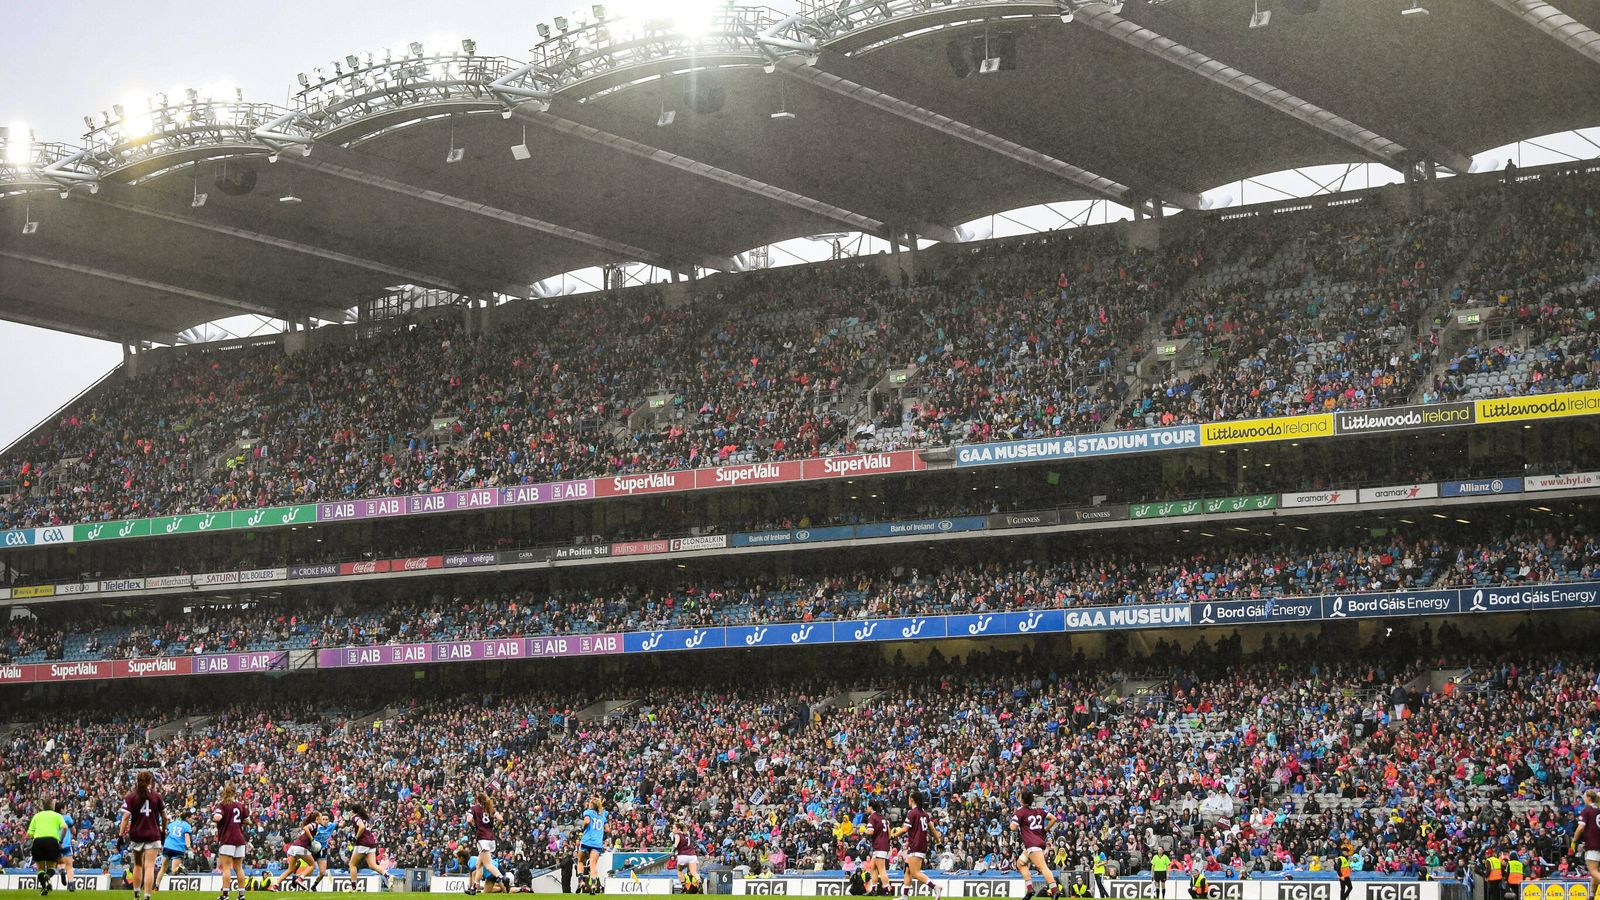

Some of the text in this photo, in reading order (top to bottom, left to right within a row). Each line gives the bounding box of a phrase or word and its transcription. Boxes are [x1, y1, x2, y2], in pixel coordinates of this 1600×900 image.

[959, 430, 1195, 462] GAA MUSEUM & STADIUM TOUR
[824, 455, 891, 475] SuperValu
[716, 465, 779, 485] SuperValu
[1540, 475, 1592, 487] www.hyl.ie
[614, 473, 675, 493] SuperValu
[1459, 483, 1490, 493] Allianz
[517, 488, 539, 502] AIB
[565, 483, 587, 498] AIB
[1375, 488, 1408, 498] aramark
[424, 496, 445, 510] AIB
[469, 492, 491, 505] AIB
[1297, 494, 1329, 503] aramark
[334, 504, 355, 518] AIB
[379, 500, 399, 514] AIB
[199, 514, 215, 530] eir
[248, 510, 265, 525] eir
[282, 507, 299, 524] eir
[1012, 516, 1040, 524] GUINNESS
[1082, 512, 1110, 520] GUINNESS
[88, 524, 103, 539] eir
[119, 521, 135, 537] eir
[166, 517, 183, 532] eir
[890, 525, 906, 533] Bank
[913, 523, 935, 531] Ireland
[6, 532, 27, 545] GAA
[43, 529, 64, 542] GAA
[682, 536, 724, 546] CLONDALKIN
[770, 533, 790, 541] Ireland
[556, 550, 567, 558] An
[594, 546, 608, 555] Stil
[240, 572, 250, 581] OIL
[251, 570, 274, 580] BOILERS
[298, 565, 336, 576] CROKE PARK
[206, 573, 237, 583] SATURN
[104, 580, 141, 591] Teleflex
[1348, 597, 1450, 612] Bord Gáis Energy
[1489, 590, 1597, 606] Bord Gáis Energy
[1066, 607, 1189, 627] GAA MUSEUM
[1217, 604, 1312, 618] Bord Gái Energy
[902, 618, 926, 638] eir
[968, 615, 993, 635] eir
[1018, 612, 1044, 632] eir
[746, 626, 768, 645] eir
[791, 624, 814, 643] eir
[854, 621, 877, 640] eir
[594, 637, 617, 651] AIB
[642, 633, 663, 650] eir
[685, 629, 707, 648] eir
[450, 644, 472, 659] AIB
[497, 642, 519, 656] AIB
[545, 639, 568, 654] AIB
[360, 649, 381, 663] AIB
[405, 647, 426, 661] AIB
[51, 663, 98, 679] SuperValu
[128, 658, 176, 676] SuperValu
[209, 658, 228, 671] AIB
[140, 799, 152, 817] 4
[233, 808, 241, 823] 2
[481, 813, 490, 824] 8
[1027, 814, 1043, 830] 22
[172, 825, 182, 837] 13
[592, 817, 603, 831] 10
[416, 871, 422, 881] 5
[722, 874, 728, 883] 6
[73, 878, 96, 890] G4
[171, 879, 200, 891] TG4
[334, 879, 365, 892] TG4
[748, 882, 785, 895] TG4
[965, 883, 1007, 897] TG4
[1207, 884, 1241, 899] G4
[1280, 885, 1328, 900] TG4
[1368, 885, 1418, 900] TG4
